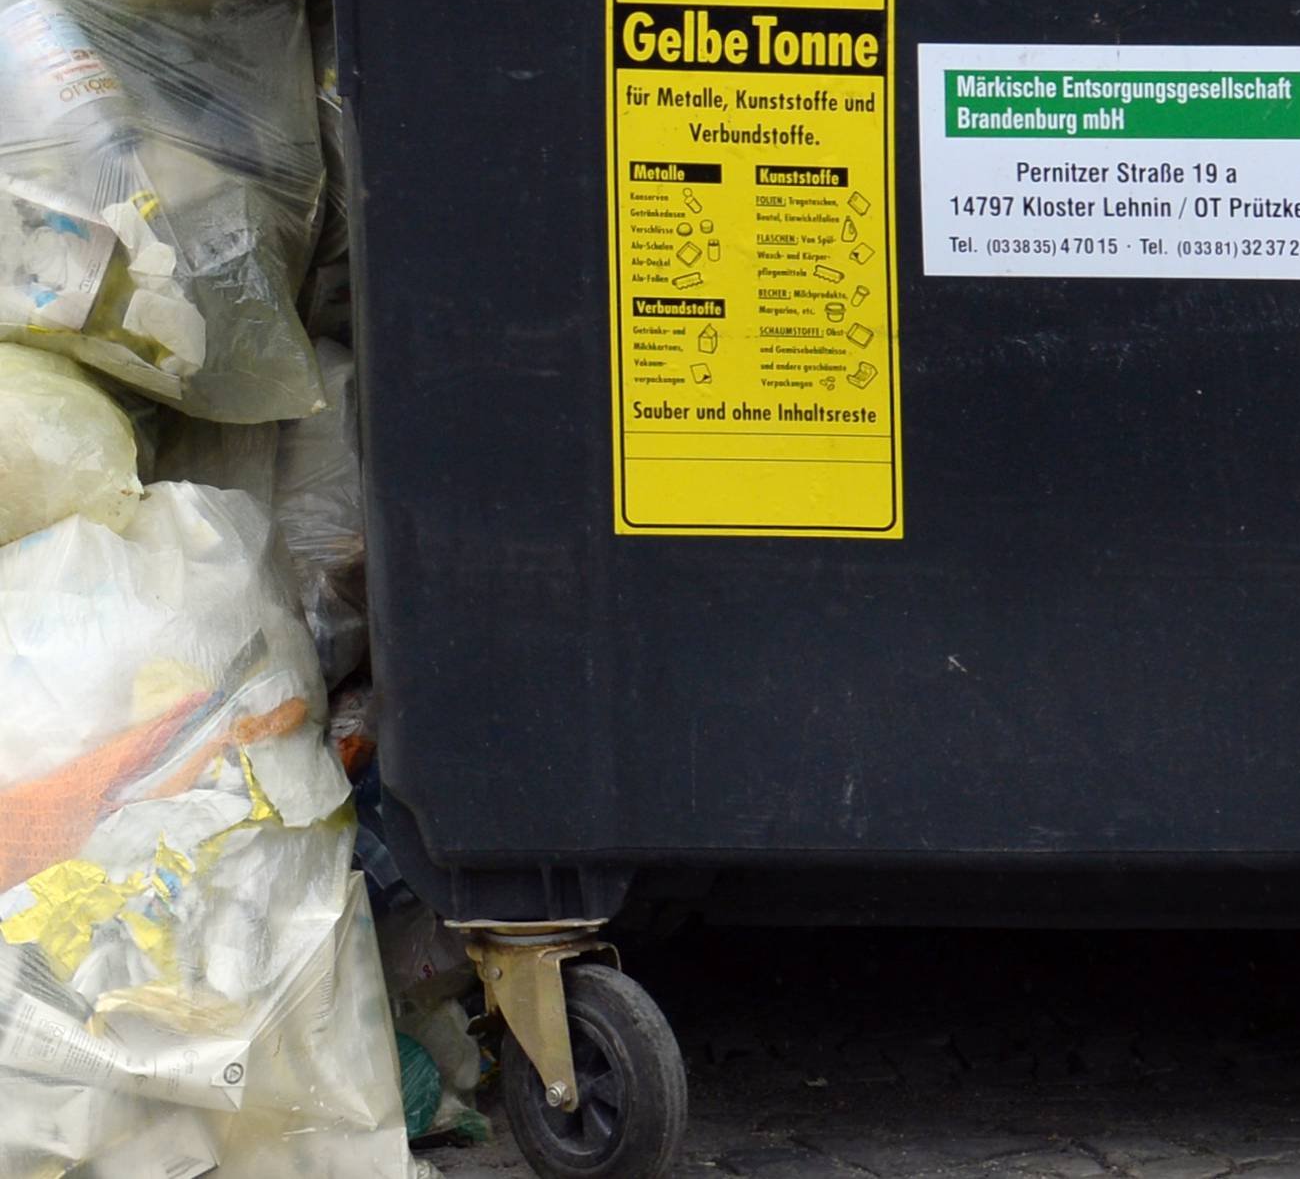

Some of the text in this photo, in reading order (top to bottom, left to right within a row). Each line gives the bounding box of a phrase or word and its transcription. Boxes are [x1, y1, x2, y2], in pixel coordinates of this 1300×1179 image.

[623, 10, 879, 68] Gelbe Tonne
[626, 85, 876, 113] für Metalle, Kunststoffe und
[956, 74, 1293, 104] Märkische Entsorgungsgesellschaft
[957, 106, 1125, 134] Brandenburg mbH
[689, 122, 820, 146] Verbundstoffe.
[634, 164, 840, 185] Metalle Kunststoffe
[1016, 161, 1237, 184] Pernitzer Straße 19 a
[950, 195, 1014, 217] 14797
[1023, 196, 1095, 218] Kloster
[1103, 196, 1172, 219] Lehnin
[1194, 197, 1221, 219] OT
[949, 236, 978, 254] Tel.
[1139, 237, 1168, 255] Tel.
[636, 300, 722, 316] Verbundstoffe
[633, 400, 877, 423] Sauber und ohne Inhaltsreste
